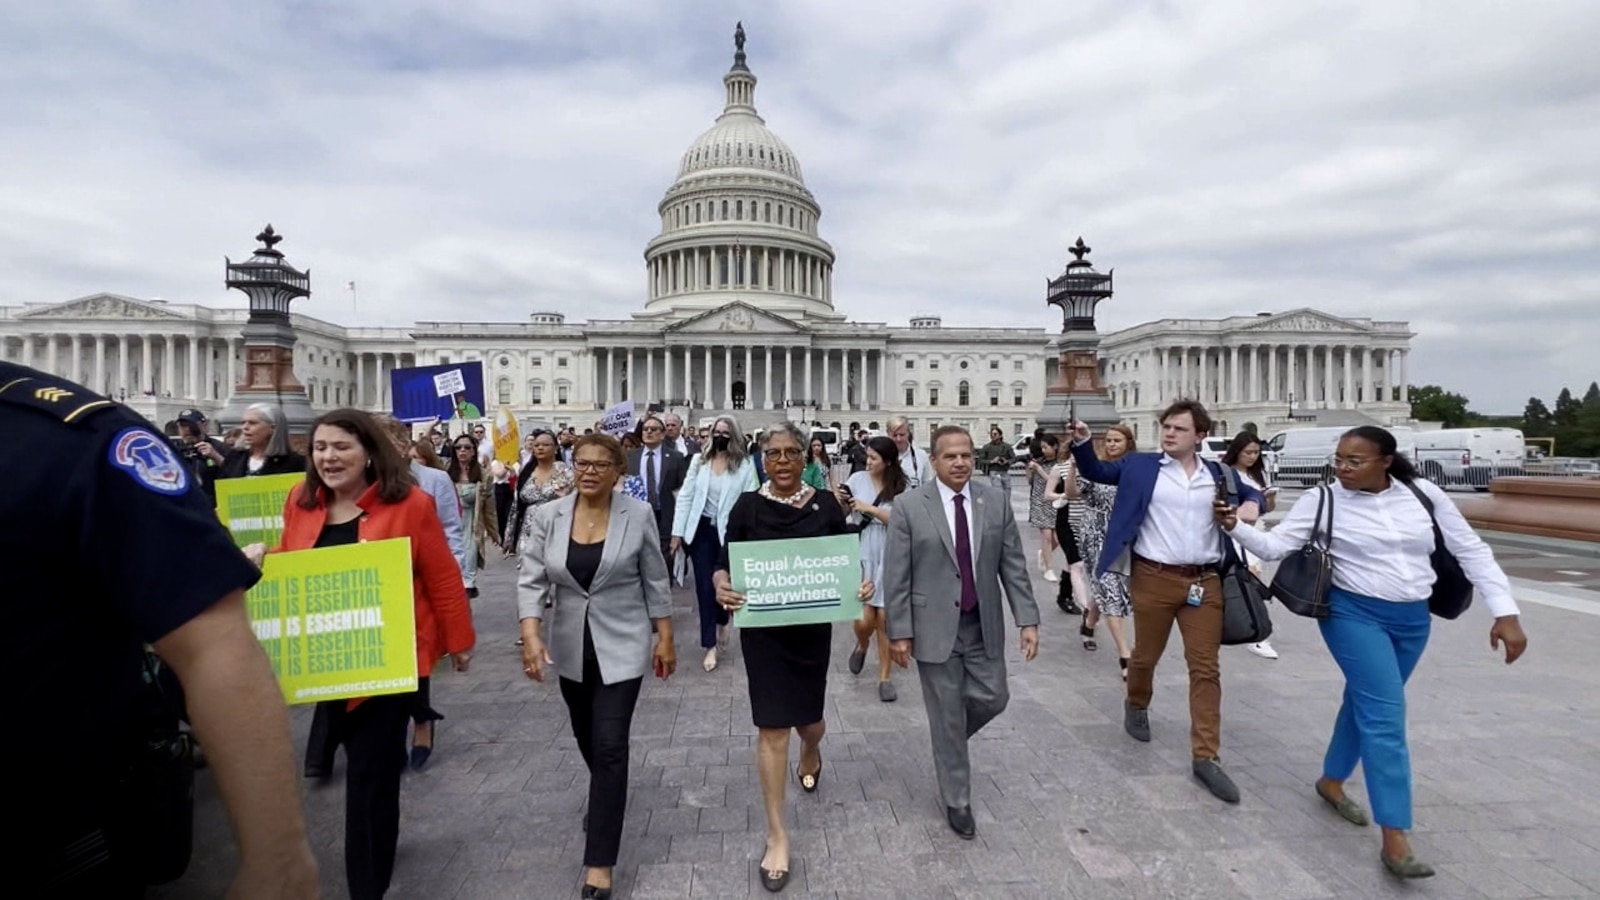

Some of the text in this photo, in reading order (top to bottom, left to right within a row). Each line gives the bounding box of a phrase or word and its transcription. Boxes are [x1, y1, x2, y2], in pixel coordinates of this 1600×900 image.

[603, 420, 628, 431] BODIES
[616, 411, 631, 420] OUR
[743, 554, 850, 575] Equal Access
[286, 577, 299, 596] IS
[305, 568, 383, 594] ESSENTIAL
[745, 570, 840, 589] to Abortion,
[287, 596, 300, 616] IS
[306, 587, 383, 614] ESSENTIAL
[746, 585, 841, 605] Everywhere.
[286, 616, 301, 636] IS
[305, 606, 385, 635] ESSENTIAL
[288, 636, 301, 656] IS
[307, 627, 385, 654] ESSENTIAL
[288, 656, 302, 676] IS
[308, 647, 387, 675] ESSENTIAL
